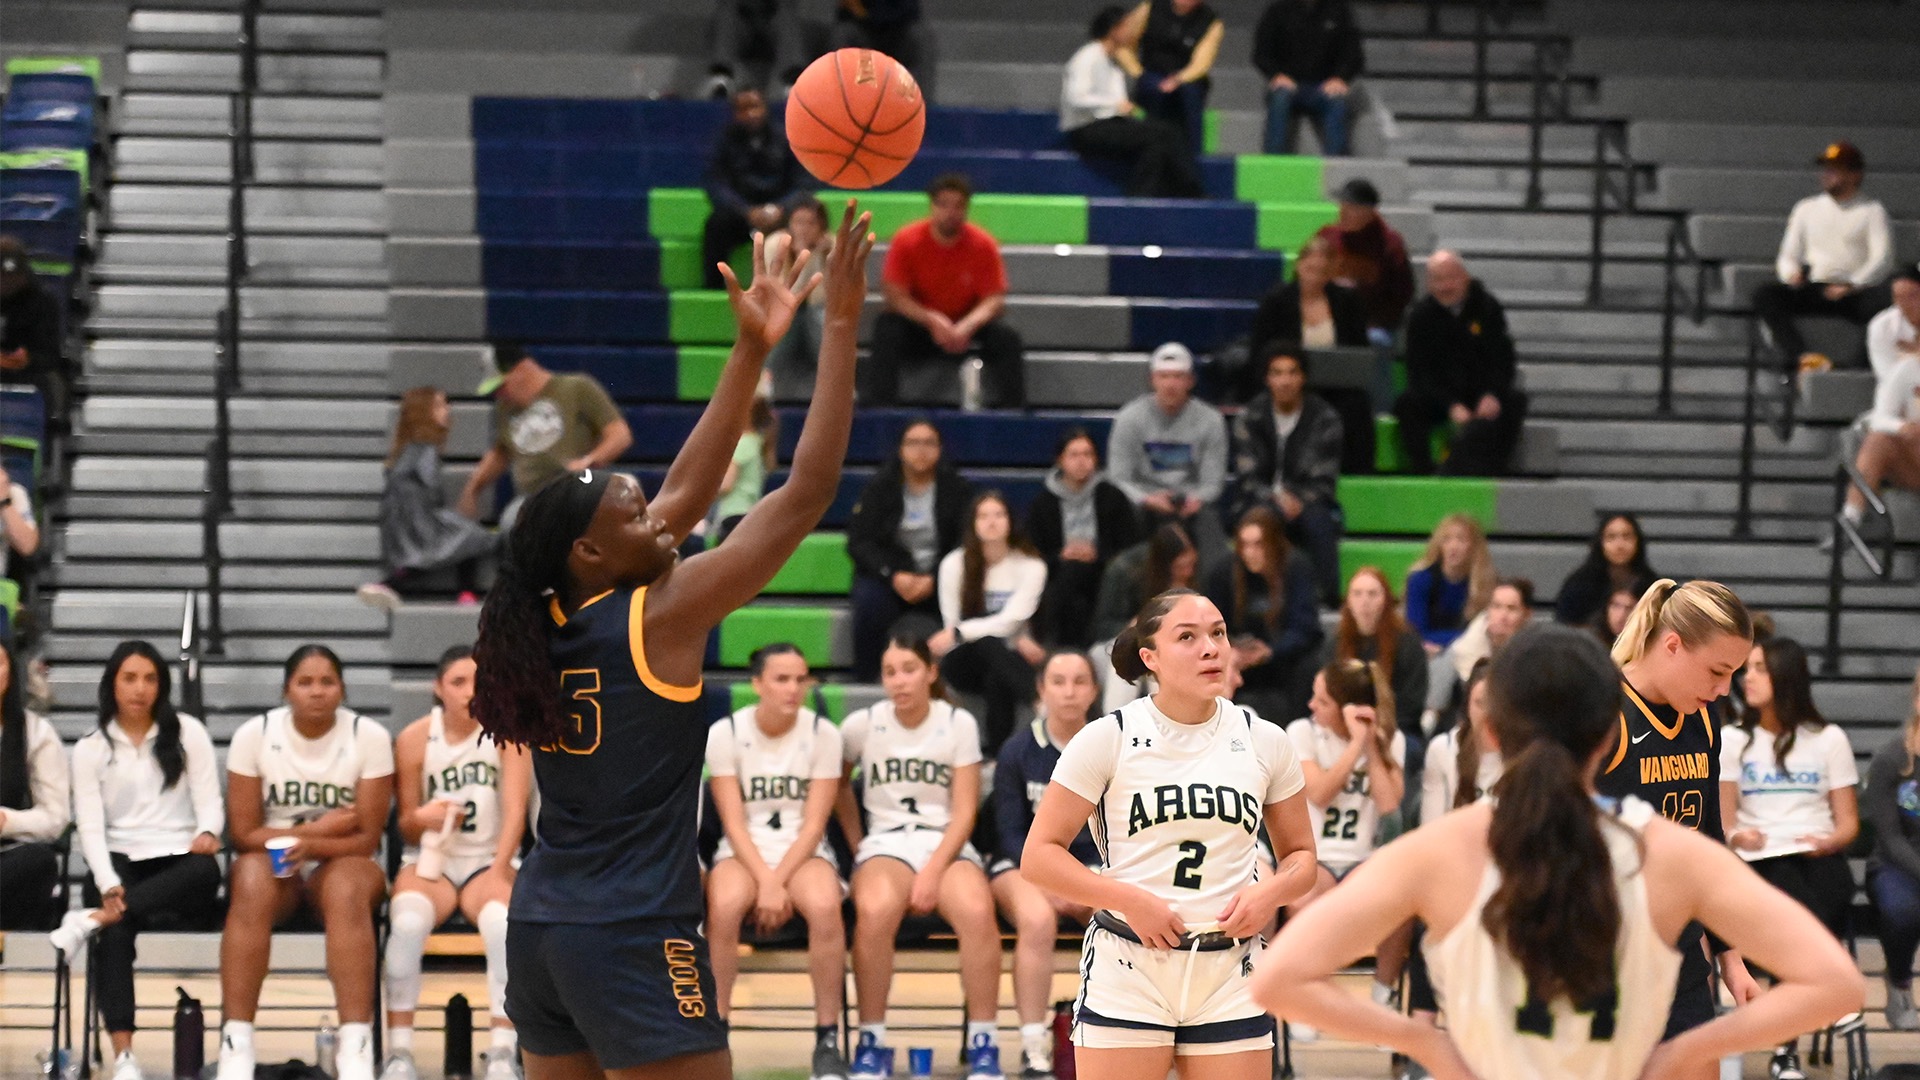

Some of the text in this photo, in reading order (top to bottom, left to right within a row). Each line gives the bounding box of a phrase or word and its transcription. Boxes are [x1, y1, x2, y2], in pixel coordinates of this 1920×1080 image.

[870, 757, 952, 788] ARGOS
[1639, 752, 1710, 785] VANGUARD
[263, 781, 356, 808] ARGOS
[1128, 783, 1259, 837] ARGOS
[1323, 807, 1359, 839] 22
[1173, 840, 1207, 890] 2
[664, 938, 706, 1018] LIONS
